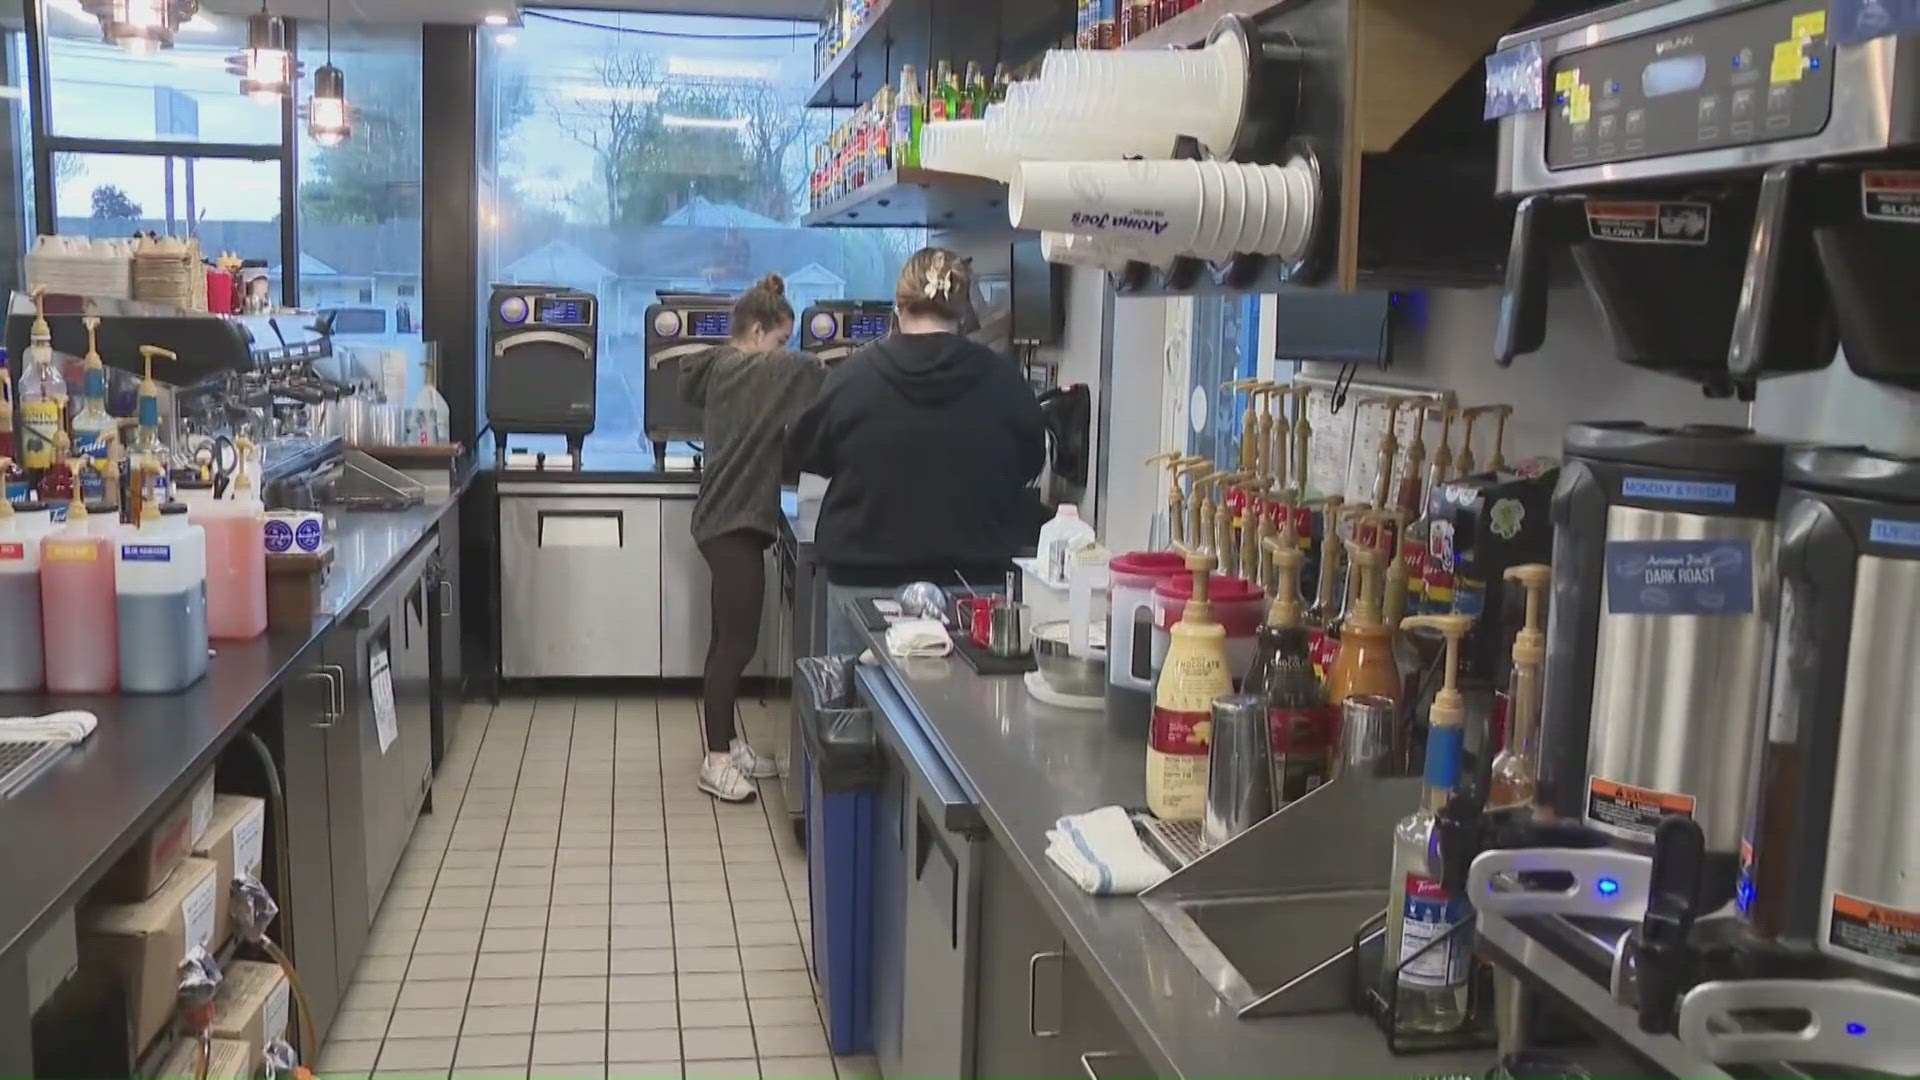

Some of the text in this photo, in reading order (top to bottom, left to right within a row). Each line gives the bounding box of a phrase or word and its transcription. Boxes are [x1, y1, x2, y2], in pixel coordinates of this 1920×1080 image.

[1112, 215, 1169, 235] Aroma
[1625, 480, 1671, 496] MONDAY
[1644, 567, 1715, 585] DARK ROAST
